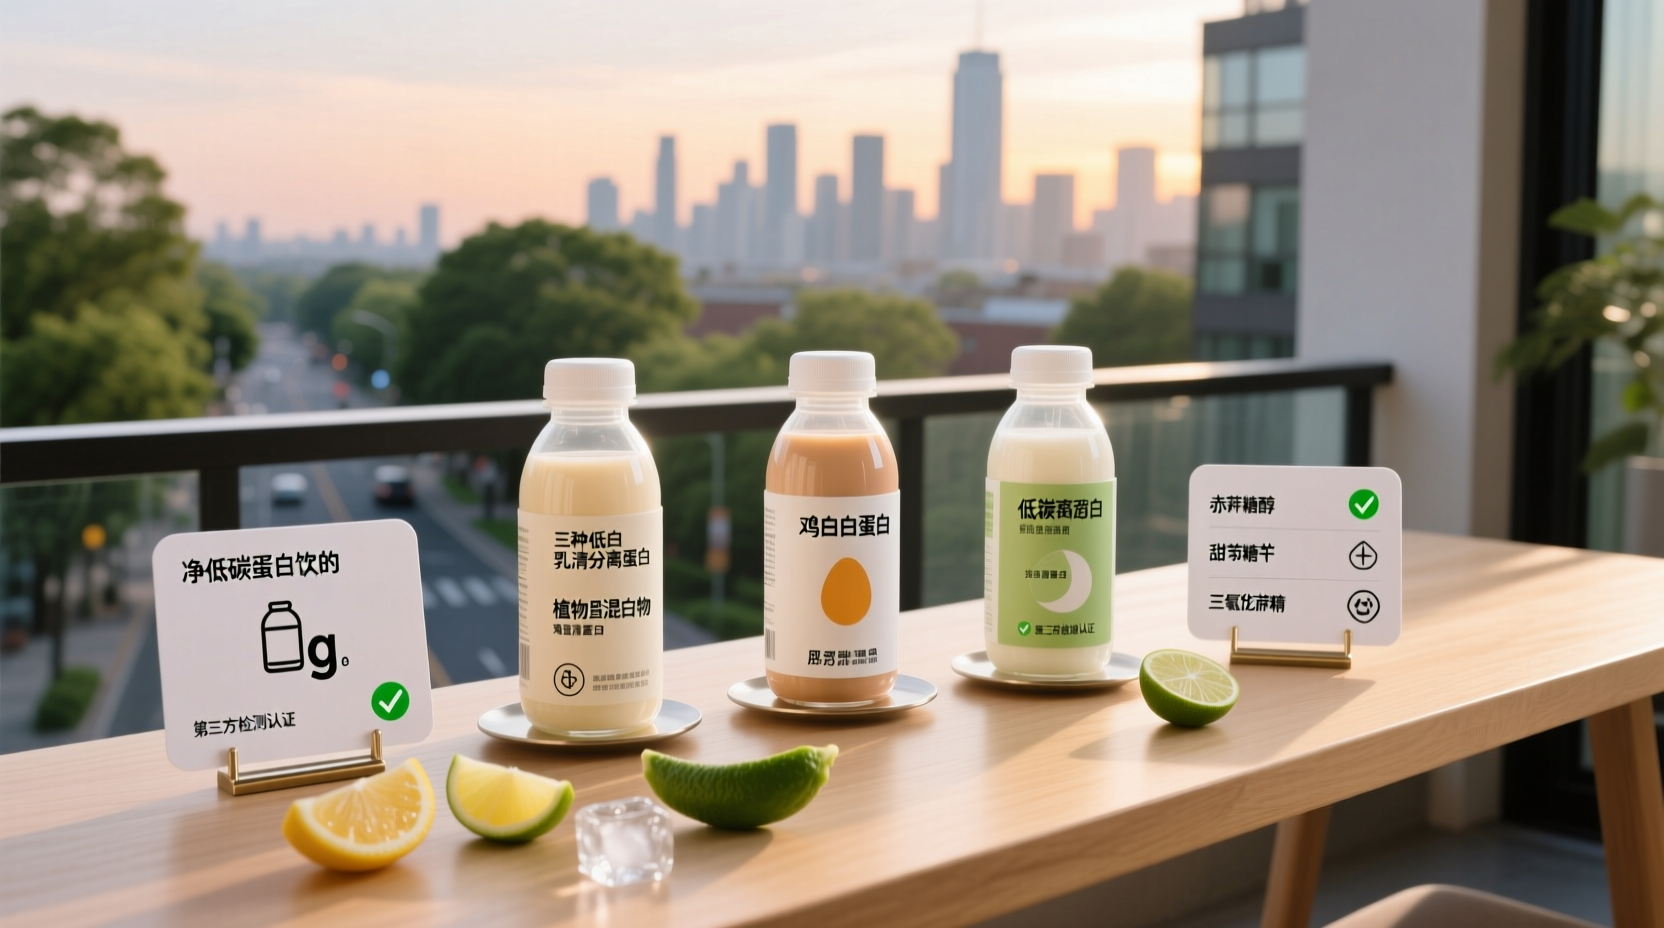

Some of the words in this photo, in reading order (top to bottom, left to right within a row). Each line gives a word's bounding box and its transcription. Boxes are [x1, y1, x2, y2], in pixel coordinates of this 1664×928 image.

[181, 550, 340, 584] 净低碳蛋白饮的
